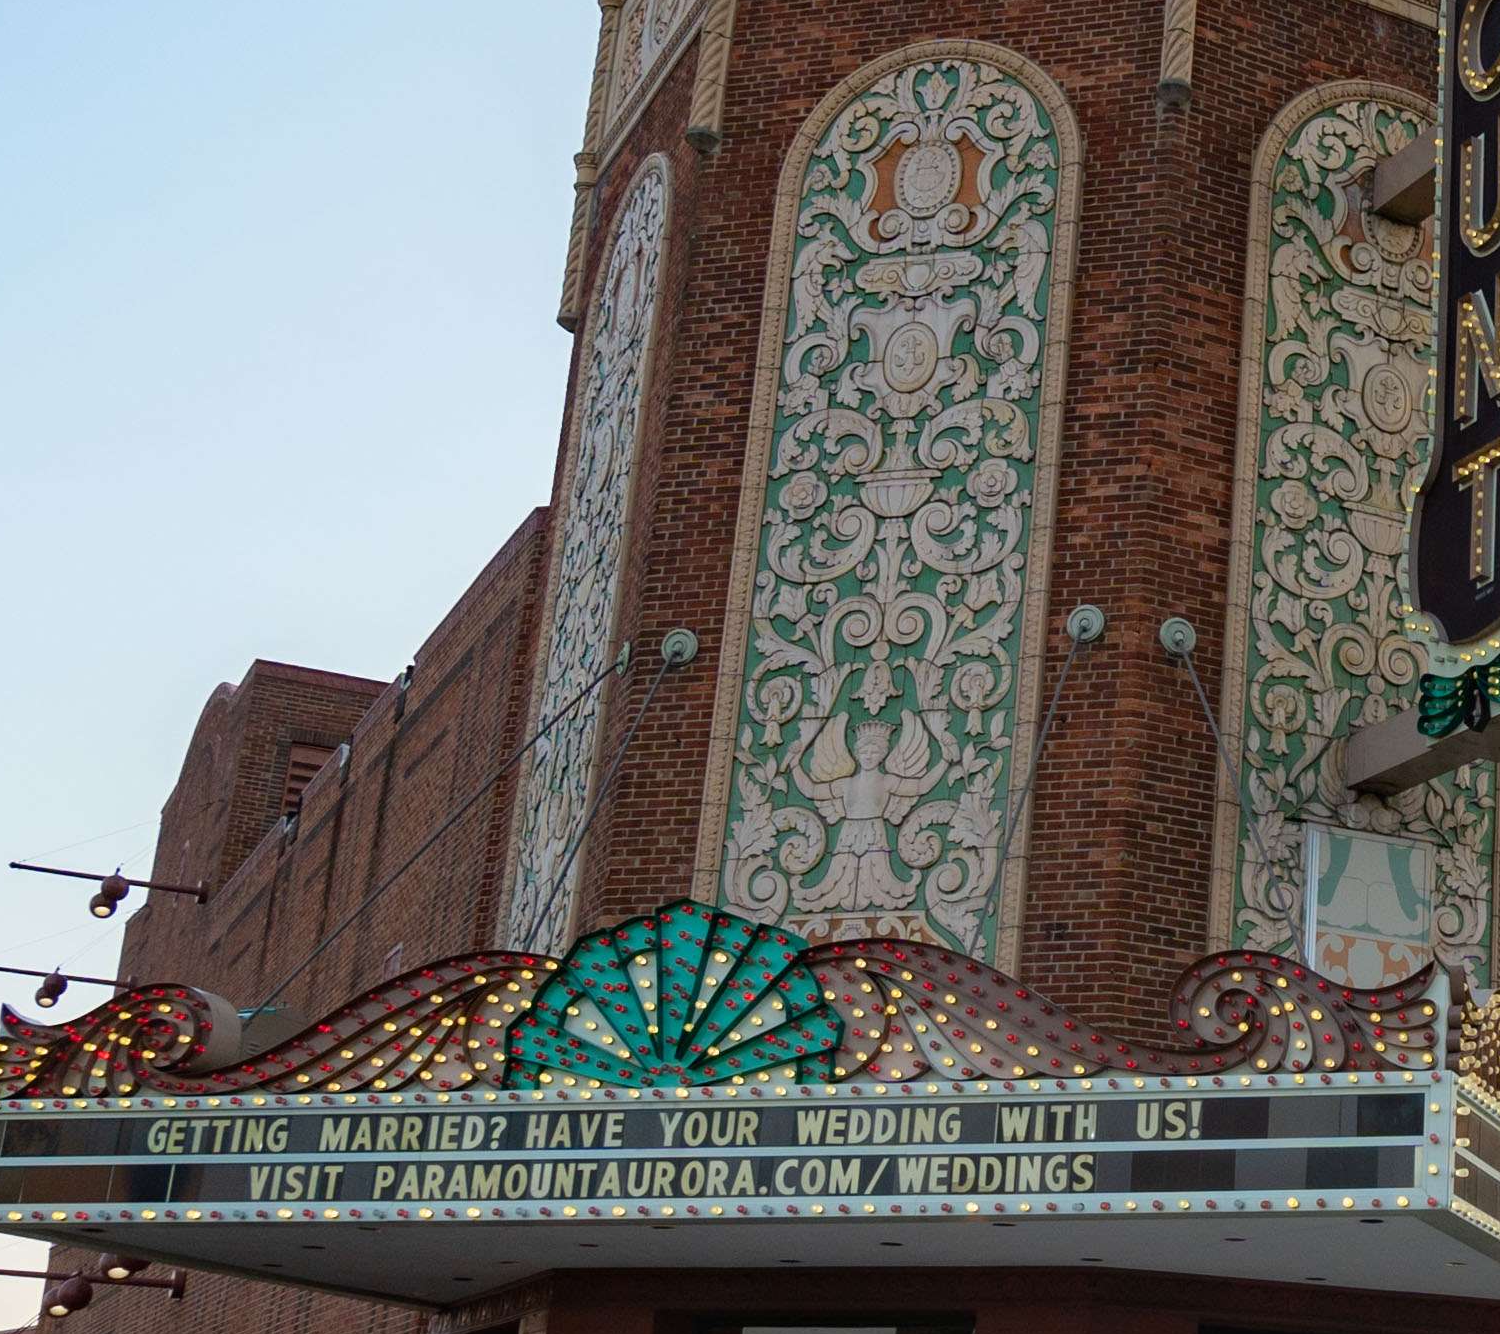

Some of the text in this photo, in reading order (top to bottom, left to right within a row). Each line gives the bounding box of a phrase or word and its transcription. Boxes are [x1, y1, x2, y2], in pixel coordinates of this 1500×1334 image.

[147, 1102, 1202, 1154] GETTING MARRIED? HAVE YOUR WEDDING WITH US!
[250, 1165, 344, 1201] VISIT
